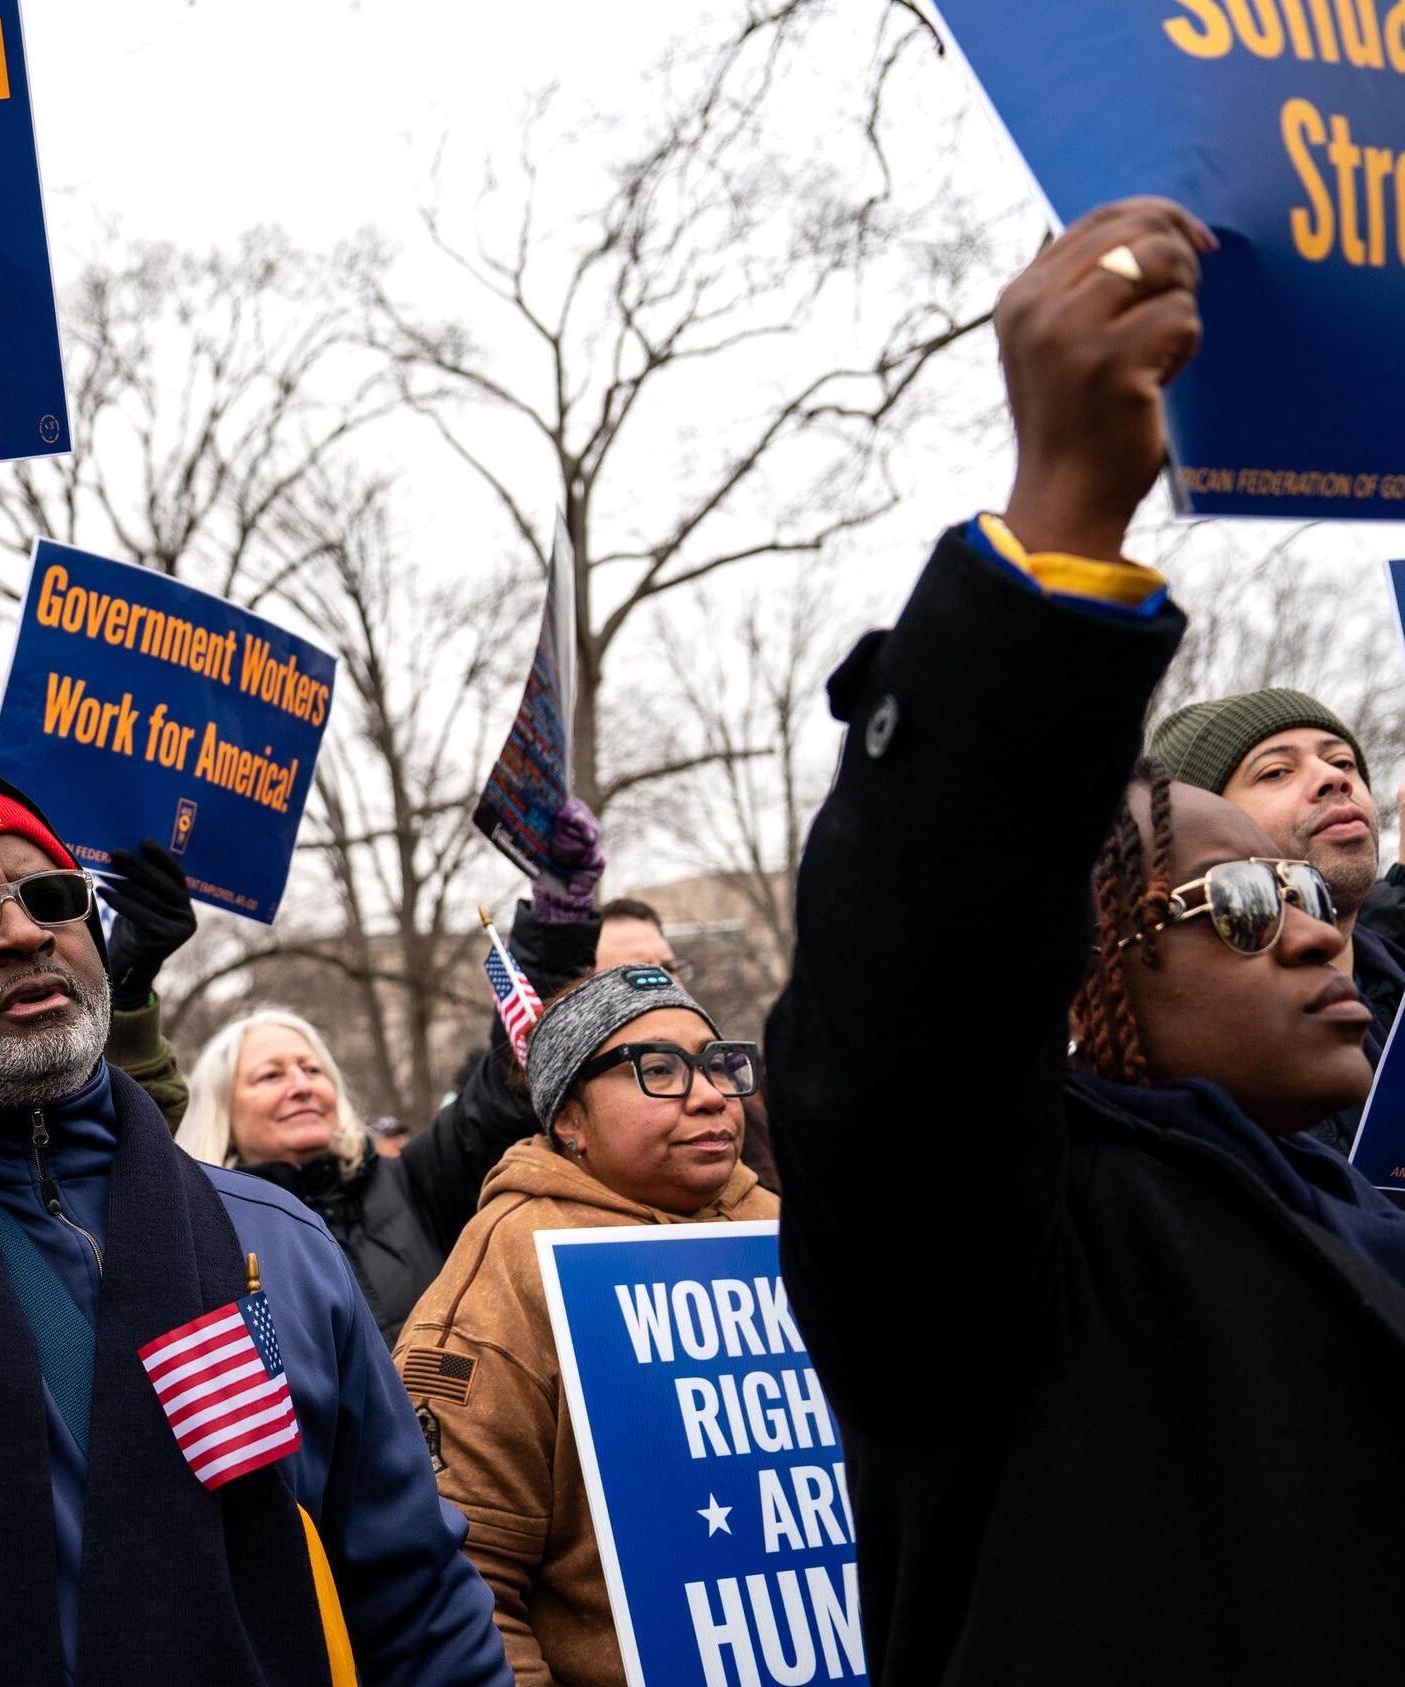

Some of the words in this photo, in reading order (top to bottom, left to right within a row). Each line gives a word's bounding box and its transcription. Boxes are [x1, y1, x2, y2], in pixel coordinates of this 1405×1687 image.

[1352, 472, 1379, 499] OF
[37, 565, 237, 685] Government
[240, 634, 330, 727] Workers
[43, 672, 139, 756] Work
[145, 703, 196, 770] for
[195, 721, 299, 813] America!
[615, 1276, 807, 1364] WORK
[675, 1367, 835, 1459] RIGH
